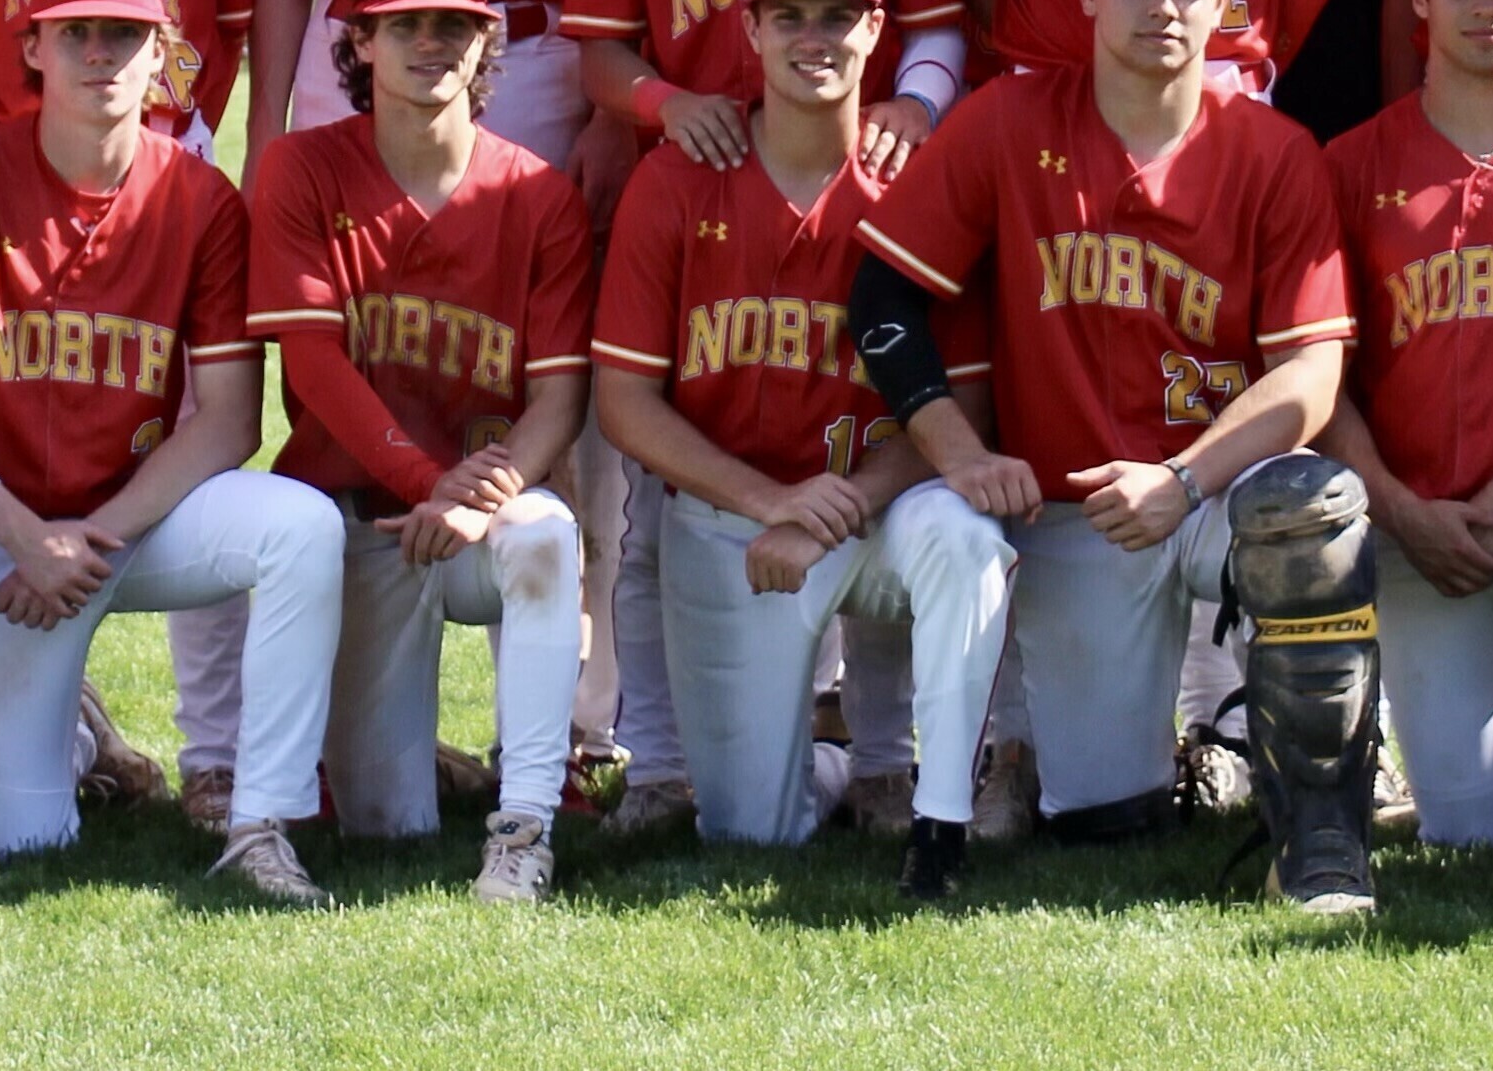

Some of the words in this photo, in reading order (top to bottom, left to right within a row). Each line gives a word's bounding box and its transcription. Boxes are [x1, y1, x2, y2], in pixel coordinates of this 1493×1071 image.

[145, 40, 202, 112] 6
[1036, 231, 1222, 347] NORTH
[680, 297, 879, 392] NORT
[1263, 618, 1370, 637] EASTON
